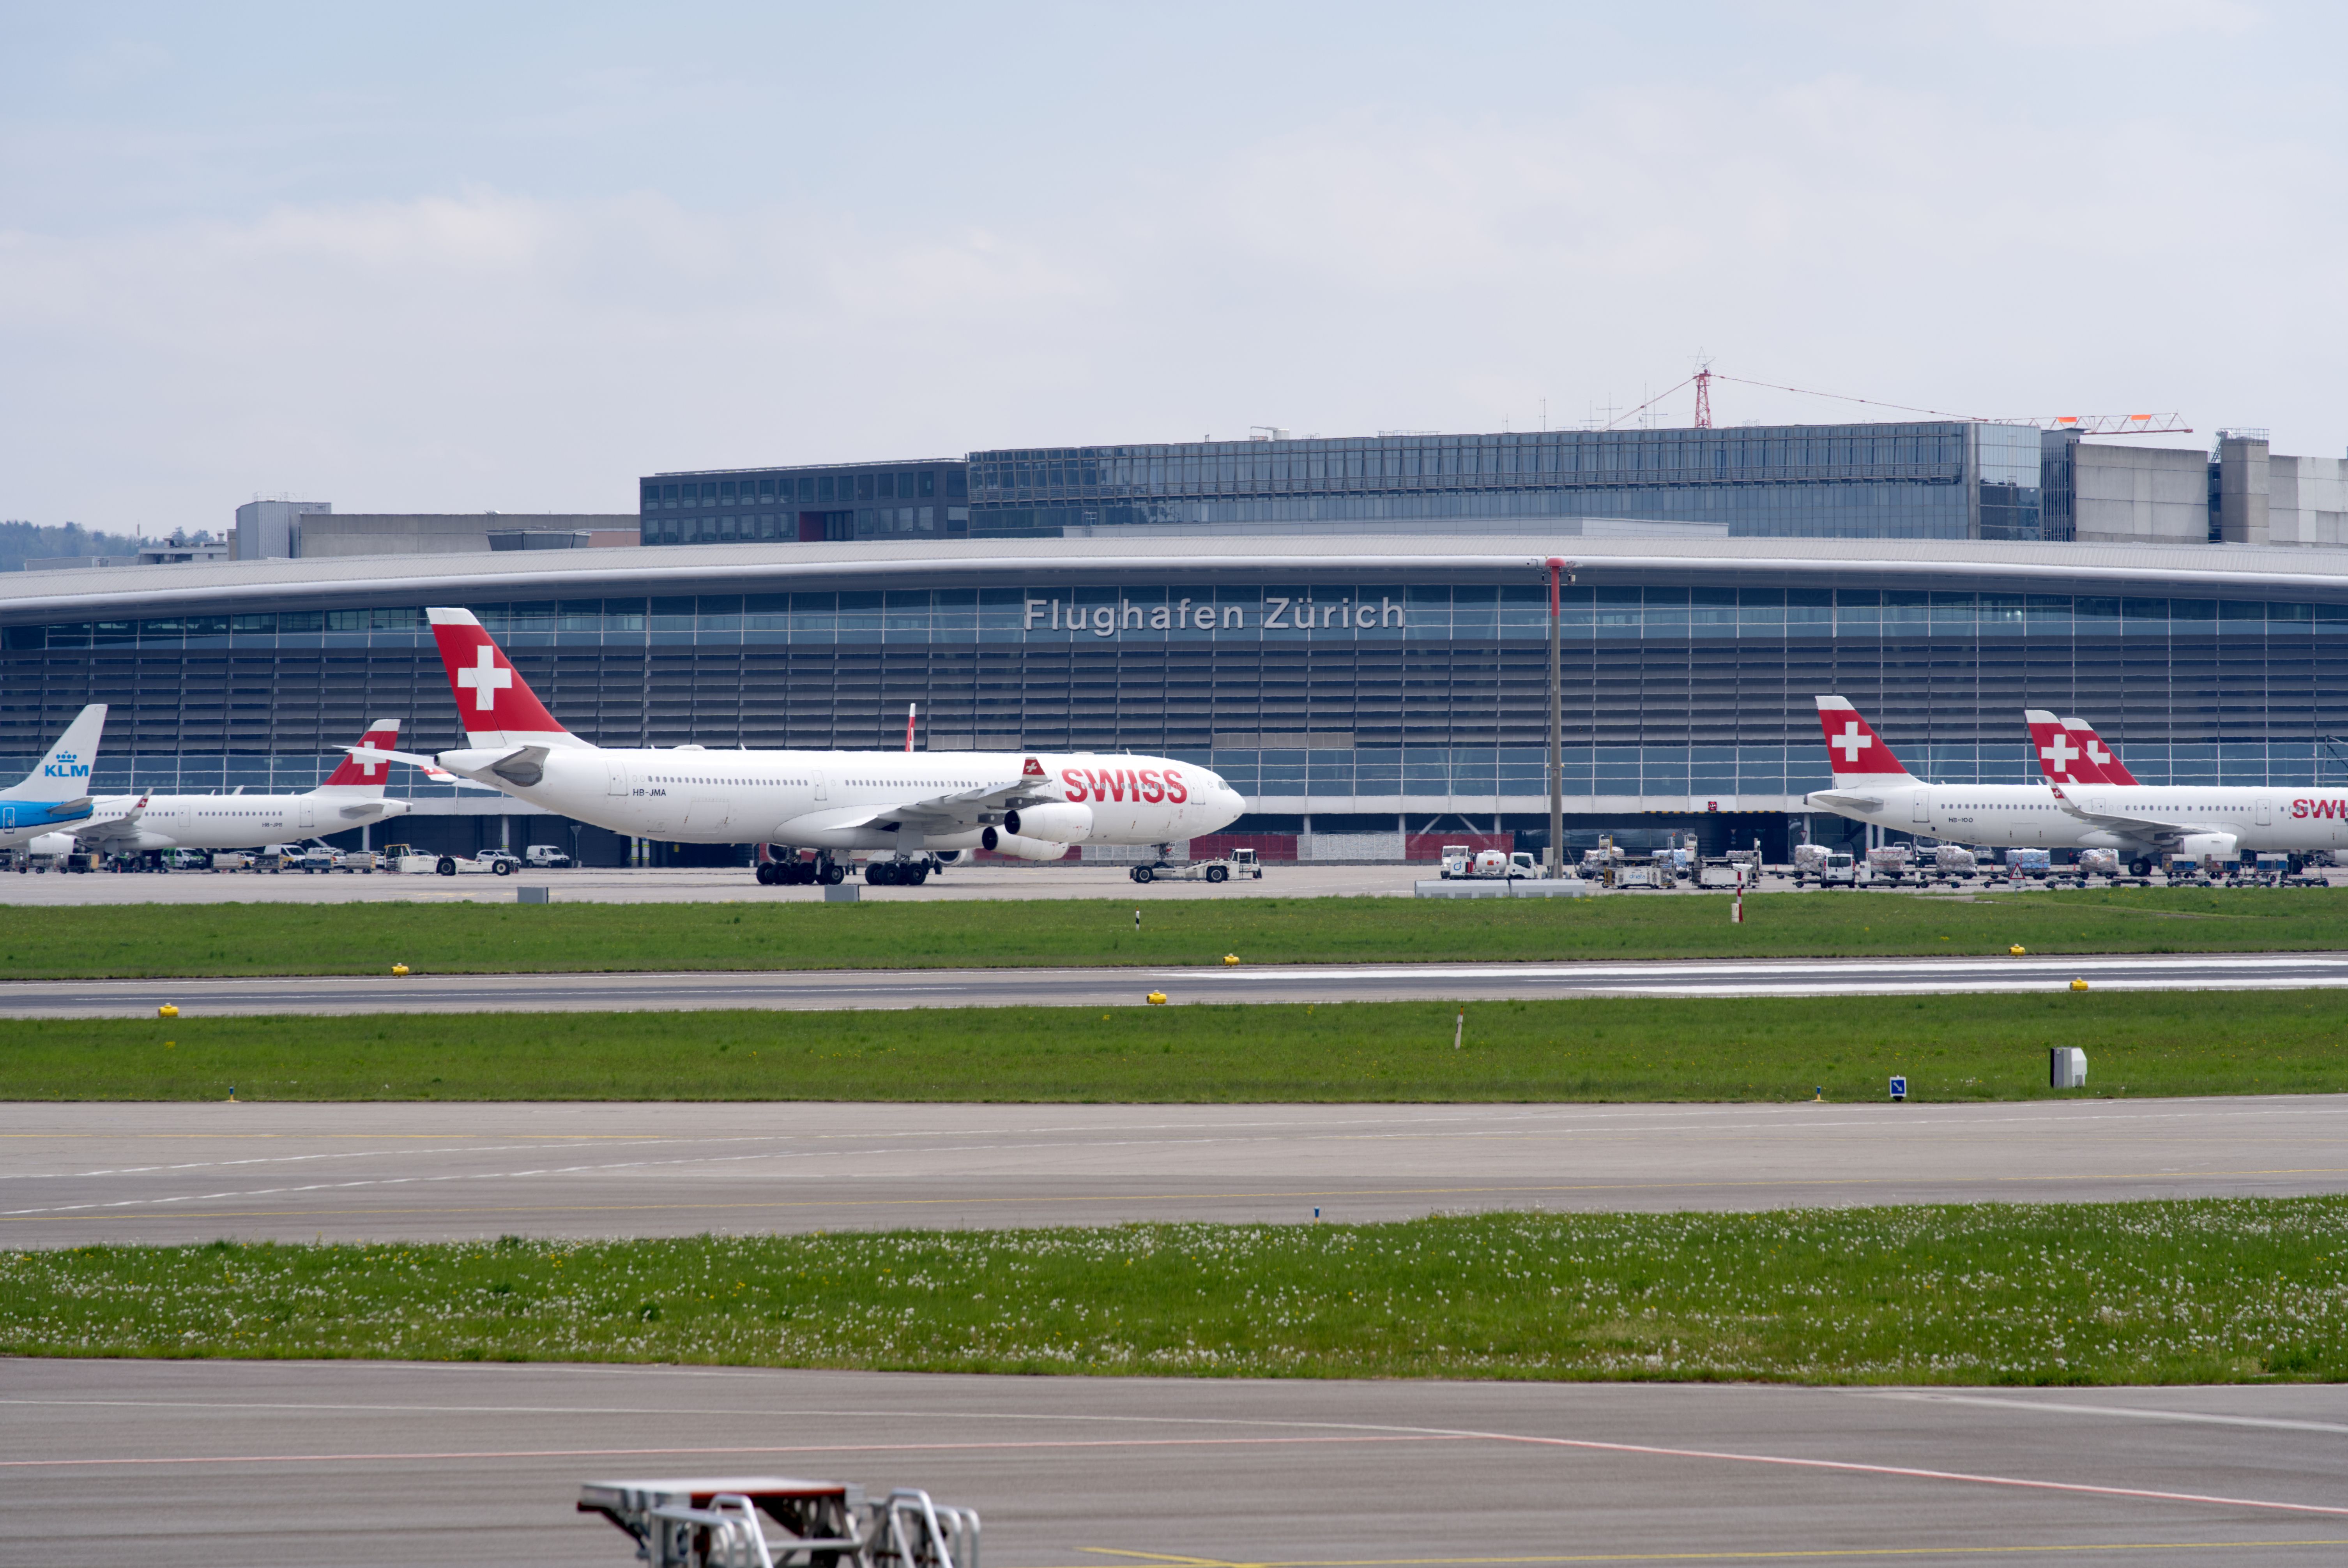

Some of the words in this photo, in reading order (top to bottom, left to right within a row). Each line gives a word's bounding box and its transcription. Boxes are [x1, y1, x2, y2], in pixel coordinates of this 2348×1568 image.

[1025, 598, 1243, 636] Flughafen
[1264, 597, 1403, 628] Zürich
[45, 765, 89, 777] KLM
[1061, 768, 1187, 803] SWISS
[2292, 799, 2348, 819] SWI
